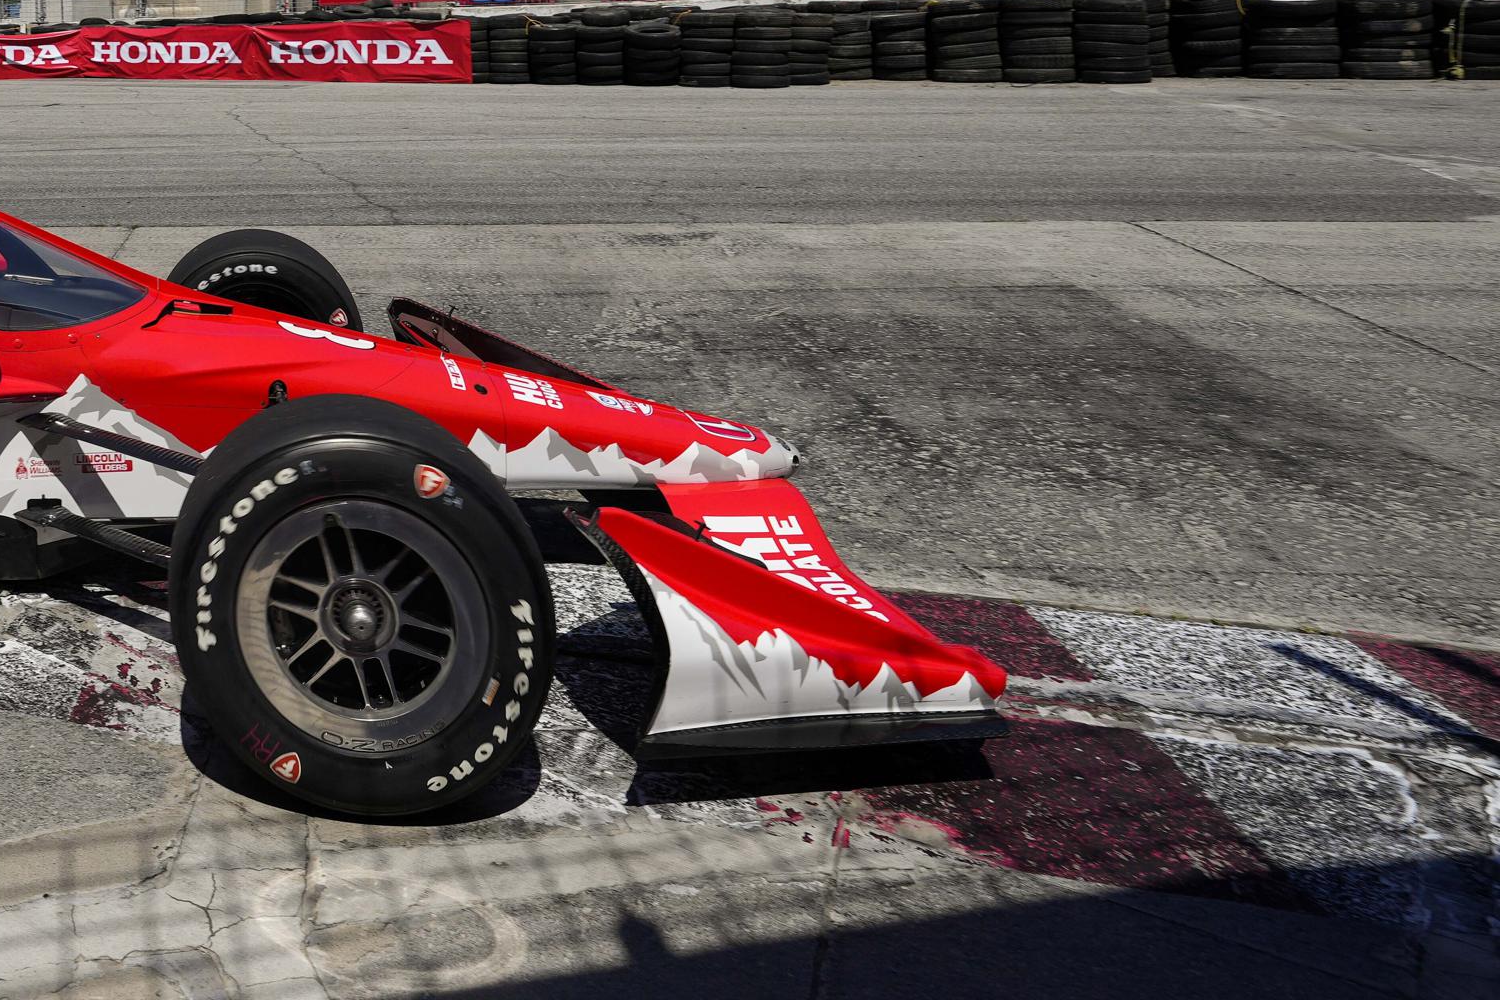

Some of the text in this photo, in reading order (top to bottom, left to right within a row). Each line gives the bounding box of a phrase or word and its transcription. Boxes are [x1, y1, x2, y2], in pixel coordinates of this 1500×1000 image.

[91, 41, 242, 64] HONDA
[265, 39, 454, 65] HONDA
[77, 454, 122, 464] LINCOLN
[195, 466, 299, 652] Firestone
[425, 599, 536, 793] Firestone
[382, 719, 446, 751] RACING
